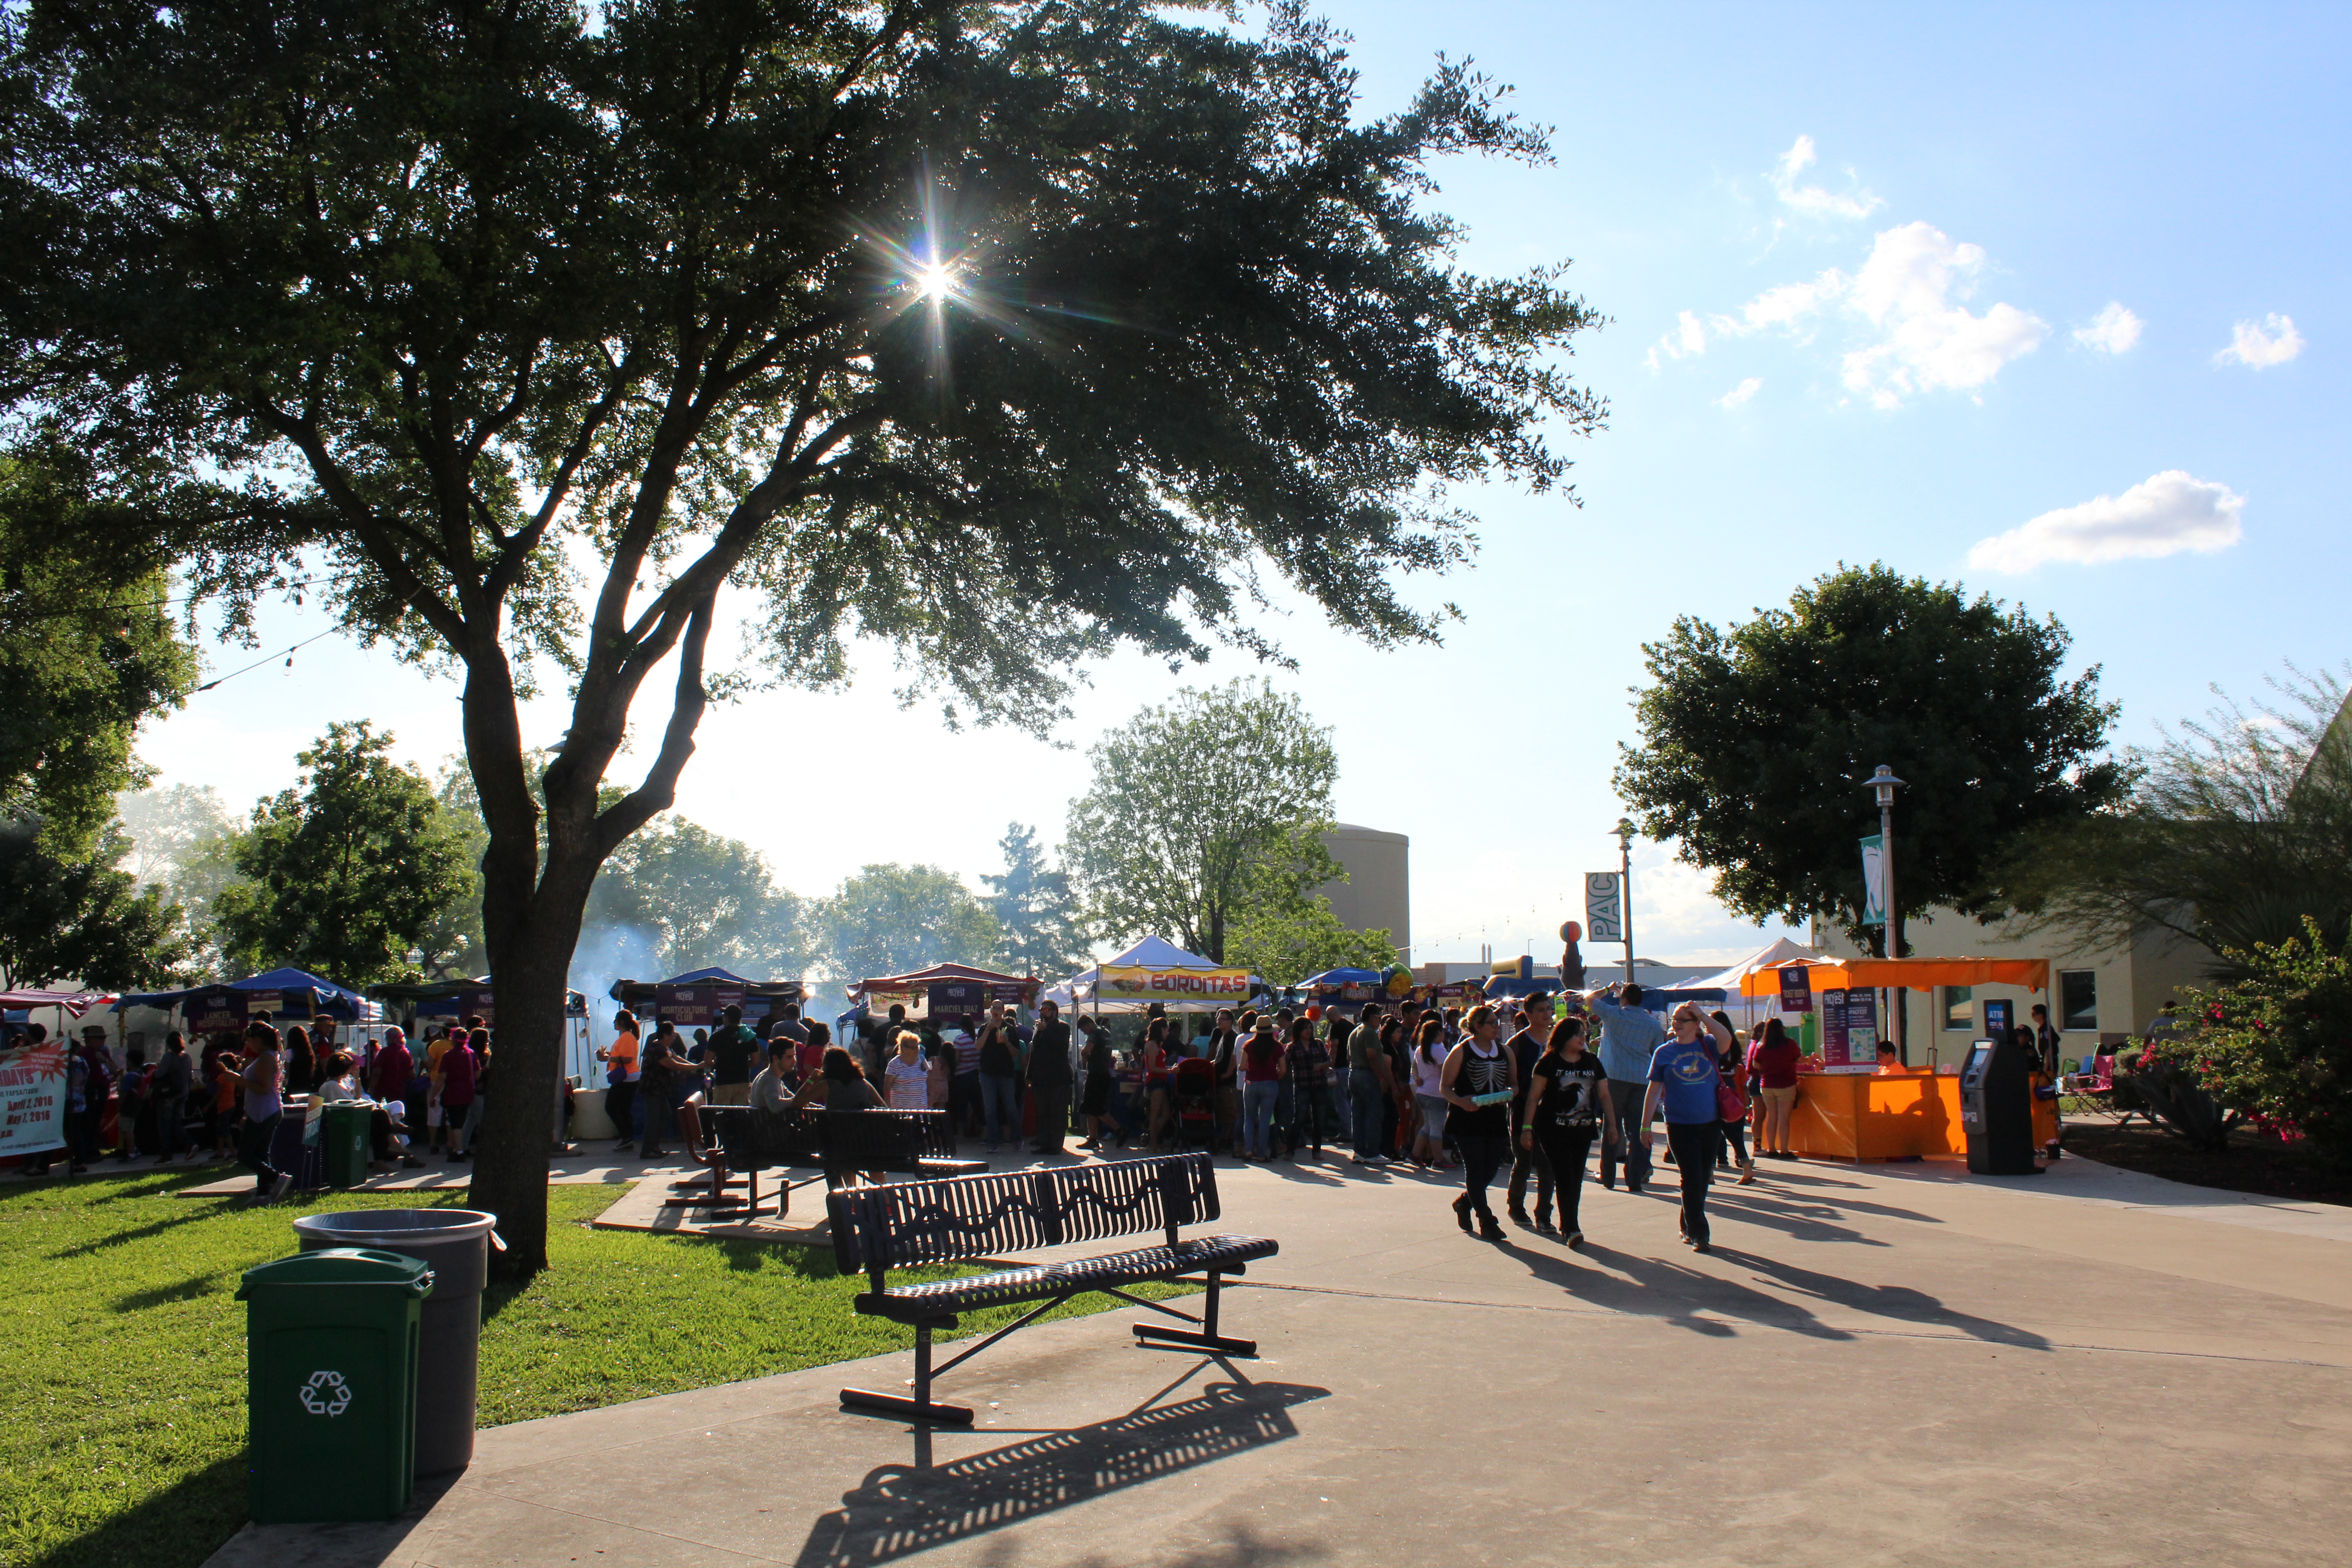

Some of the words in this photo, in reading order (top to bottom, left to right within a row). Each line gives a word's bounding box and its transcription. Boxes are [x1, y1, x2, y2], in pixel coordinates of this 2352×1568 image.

[1588, 873, 1620, 941] PAC
[1151, 974, 1245, 994] GORDITAS
[205, 1011, 230, 1020] LANCER
[661, 1006, 708, 1014] HORTICULTURE
[197, 1019, 239, 1028] HOSPITALITY
[7, 1099, 26, 1112] April
[26, 1098, 32, 1108] 2,
[34, 1095, 53, 1107] 2016
[6, 1114, 22, 1125] May
[22, 1112, 27, 1123] 7,
[30, 1110, 50, 1122] 2016
[1555, 1117, 1566, 1126] ALL
